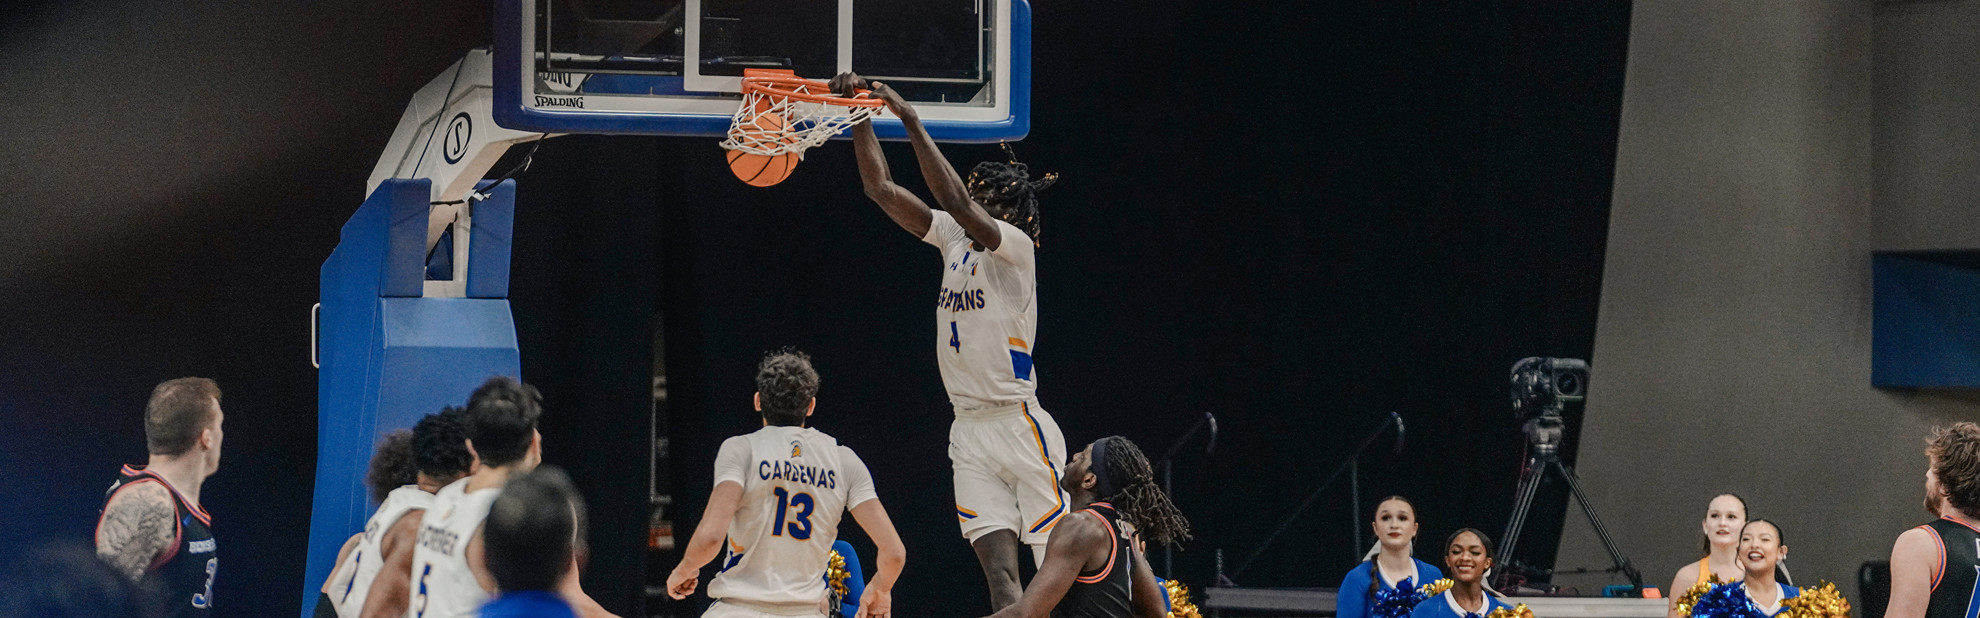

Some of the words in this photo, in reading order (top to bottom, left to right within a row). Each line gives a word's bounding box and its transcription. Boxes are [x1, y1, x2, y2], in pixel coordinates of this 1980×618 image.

[534, 95, 584, 109] SPALDING
[949, 319, 962, 354] 4
[758, 459, 836, 490] CARDENAS
[771, 485, 816, 542] 13
